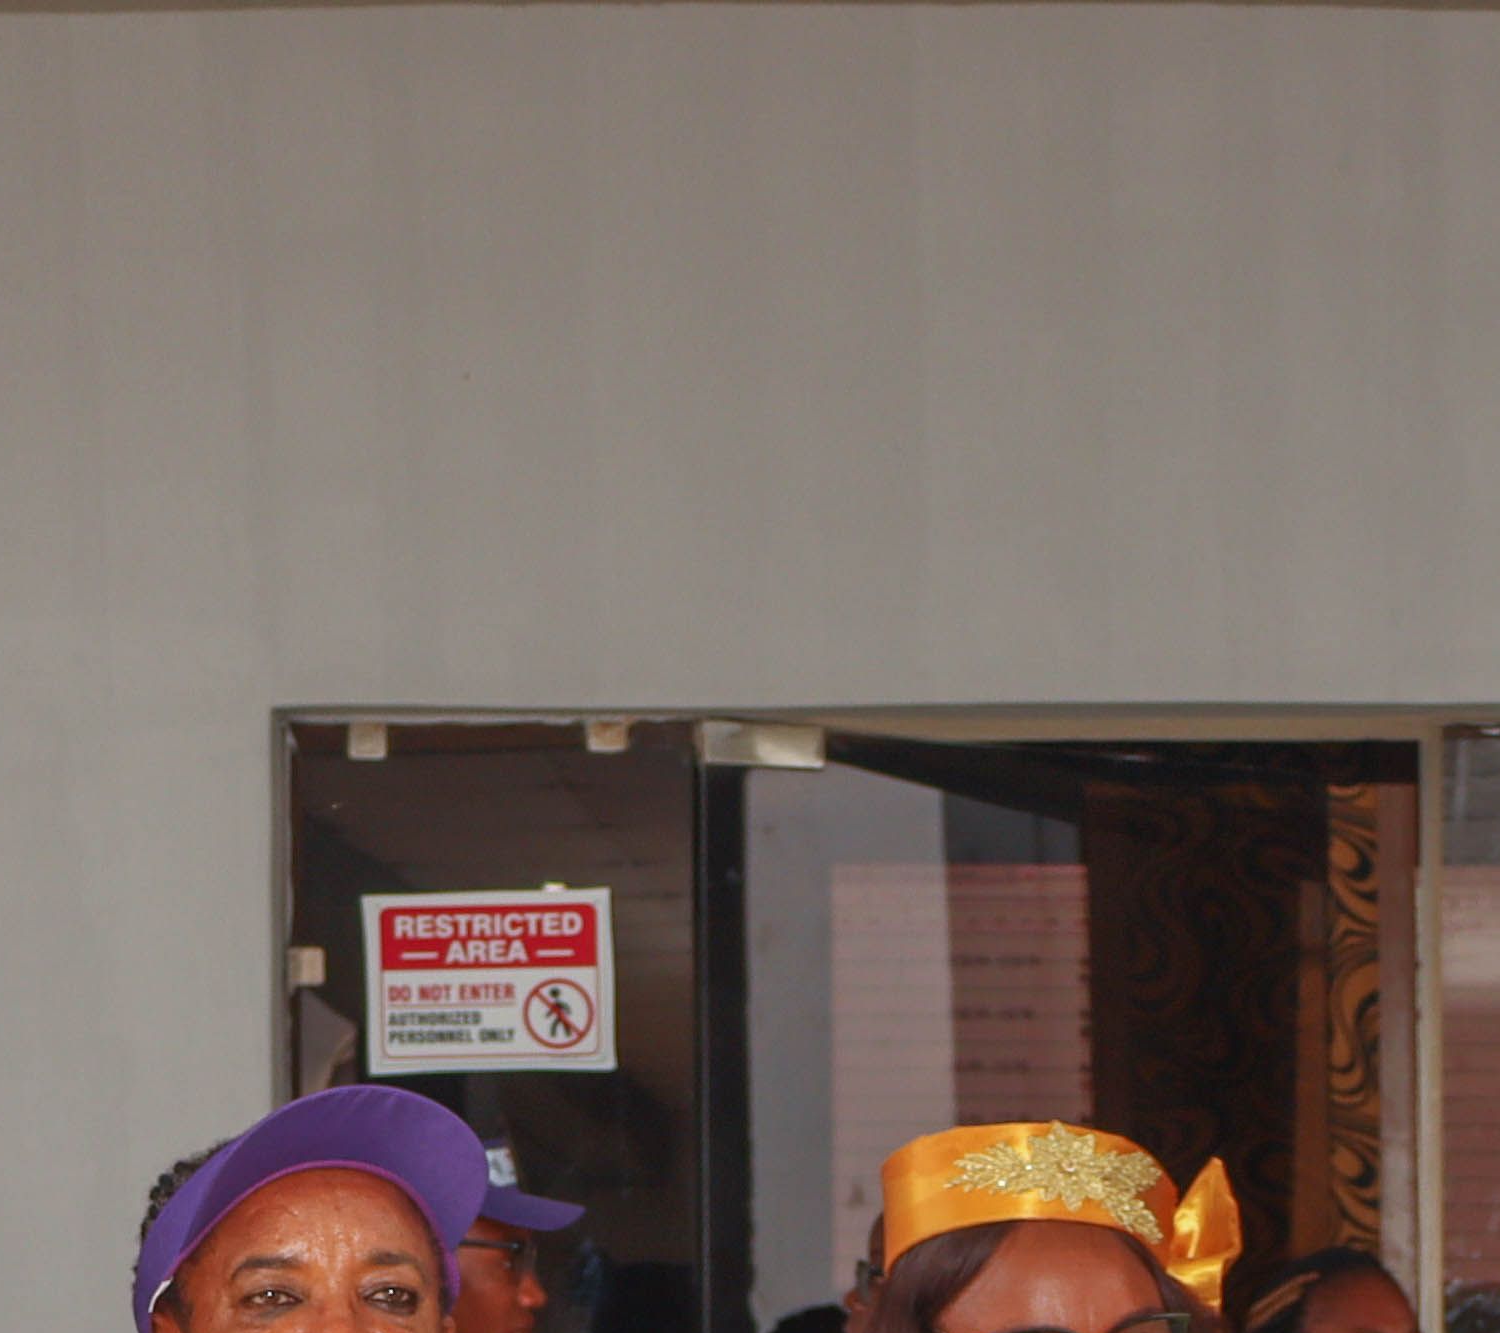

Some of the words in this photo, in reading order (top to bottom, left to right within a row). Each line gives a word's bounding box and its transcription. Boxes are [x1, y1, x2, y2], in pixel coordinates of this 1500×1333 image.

[394, 912, 582, 939] RESTRICTED
[446, 939, 528, 964] AREA
[388, 985, 412, 1002] DO
[419, 984, 452, 1001] NOT
[460, 983, 515, 1001] ENTER
[389, 1011, 482, 1026] AUTHORIZED
[389, 1029, 473, 1044] PERSONNEL
[479, 1028, 515, 1041] ONLY
